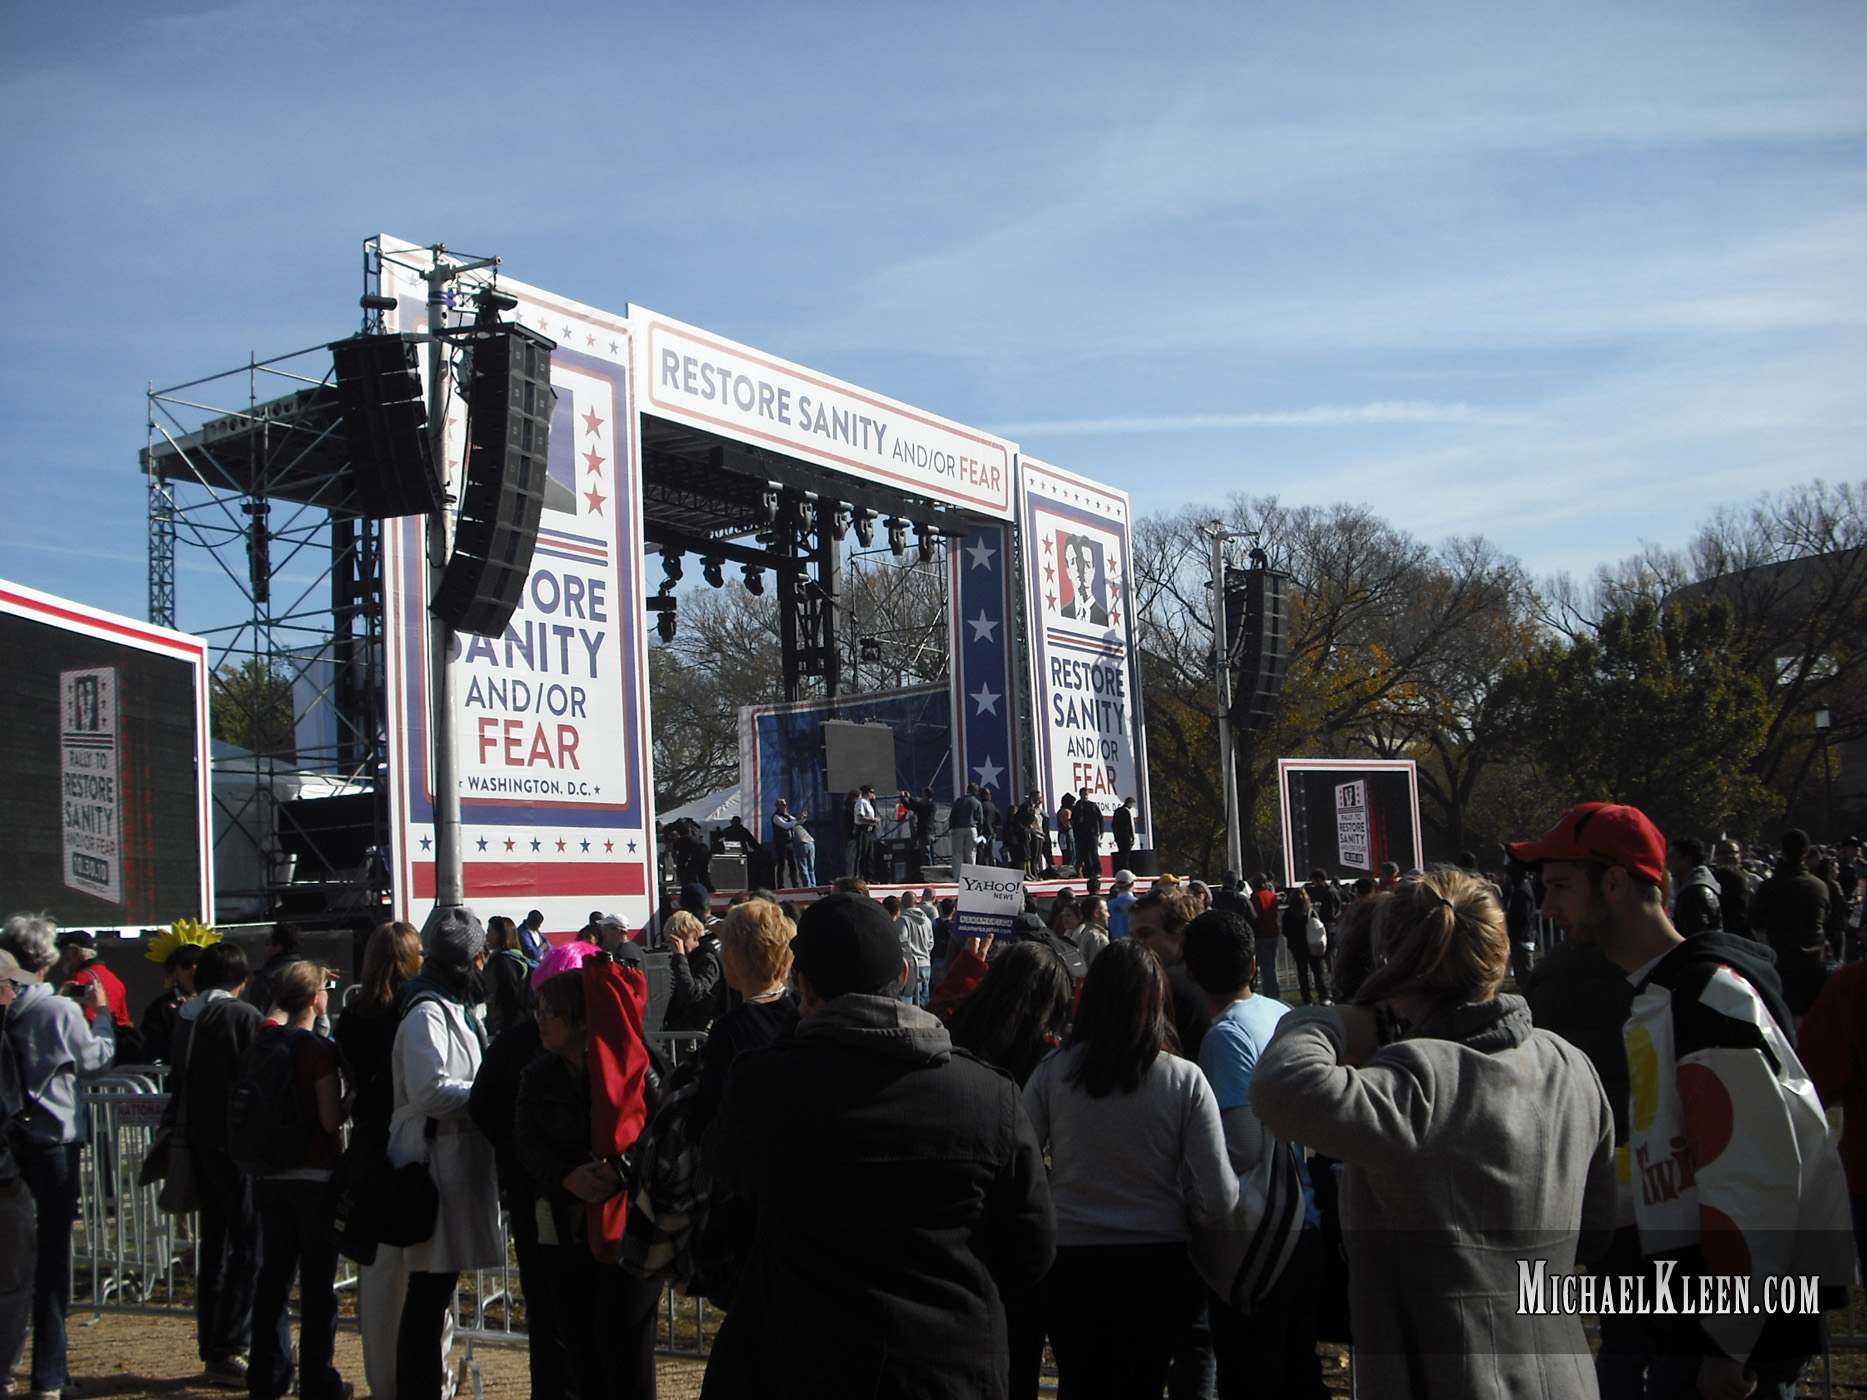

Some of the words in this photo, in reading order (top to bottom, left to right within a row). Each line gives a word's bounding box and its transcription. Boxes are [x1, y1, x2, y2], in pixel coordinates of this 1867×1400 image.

[661, 347, 791, 426] RESTORE
[798, 395, 887, 455] SANITY
[892, 437, 955, 479] AND/OR
[959, 455, 1001, 492] FEAR
[1050, 656, 1125, 698] RESTORE
[465, 674, 586, 719] AND/OR
[1054, 693, 1125, 735] SANITY
[69, 750, 92, 769] RALLY
[96, 752, 107, 770] TO
[478, 717, 581, 771] FEAR
[1067, 736, 1119, 762] AND/OR
[64, 772, 114, 804] RESTORE
[567, 781, 591, 796] D.C.
[1072, 762, 1118, 796] FEAR
[65, 800, 113, 836] SANITY
[1339, 822, 1365, 832] RESTORE
[1340, 833, 1365, 845] SANITY
[962, 876, 1020, 894] YAHOO!
